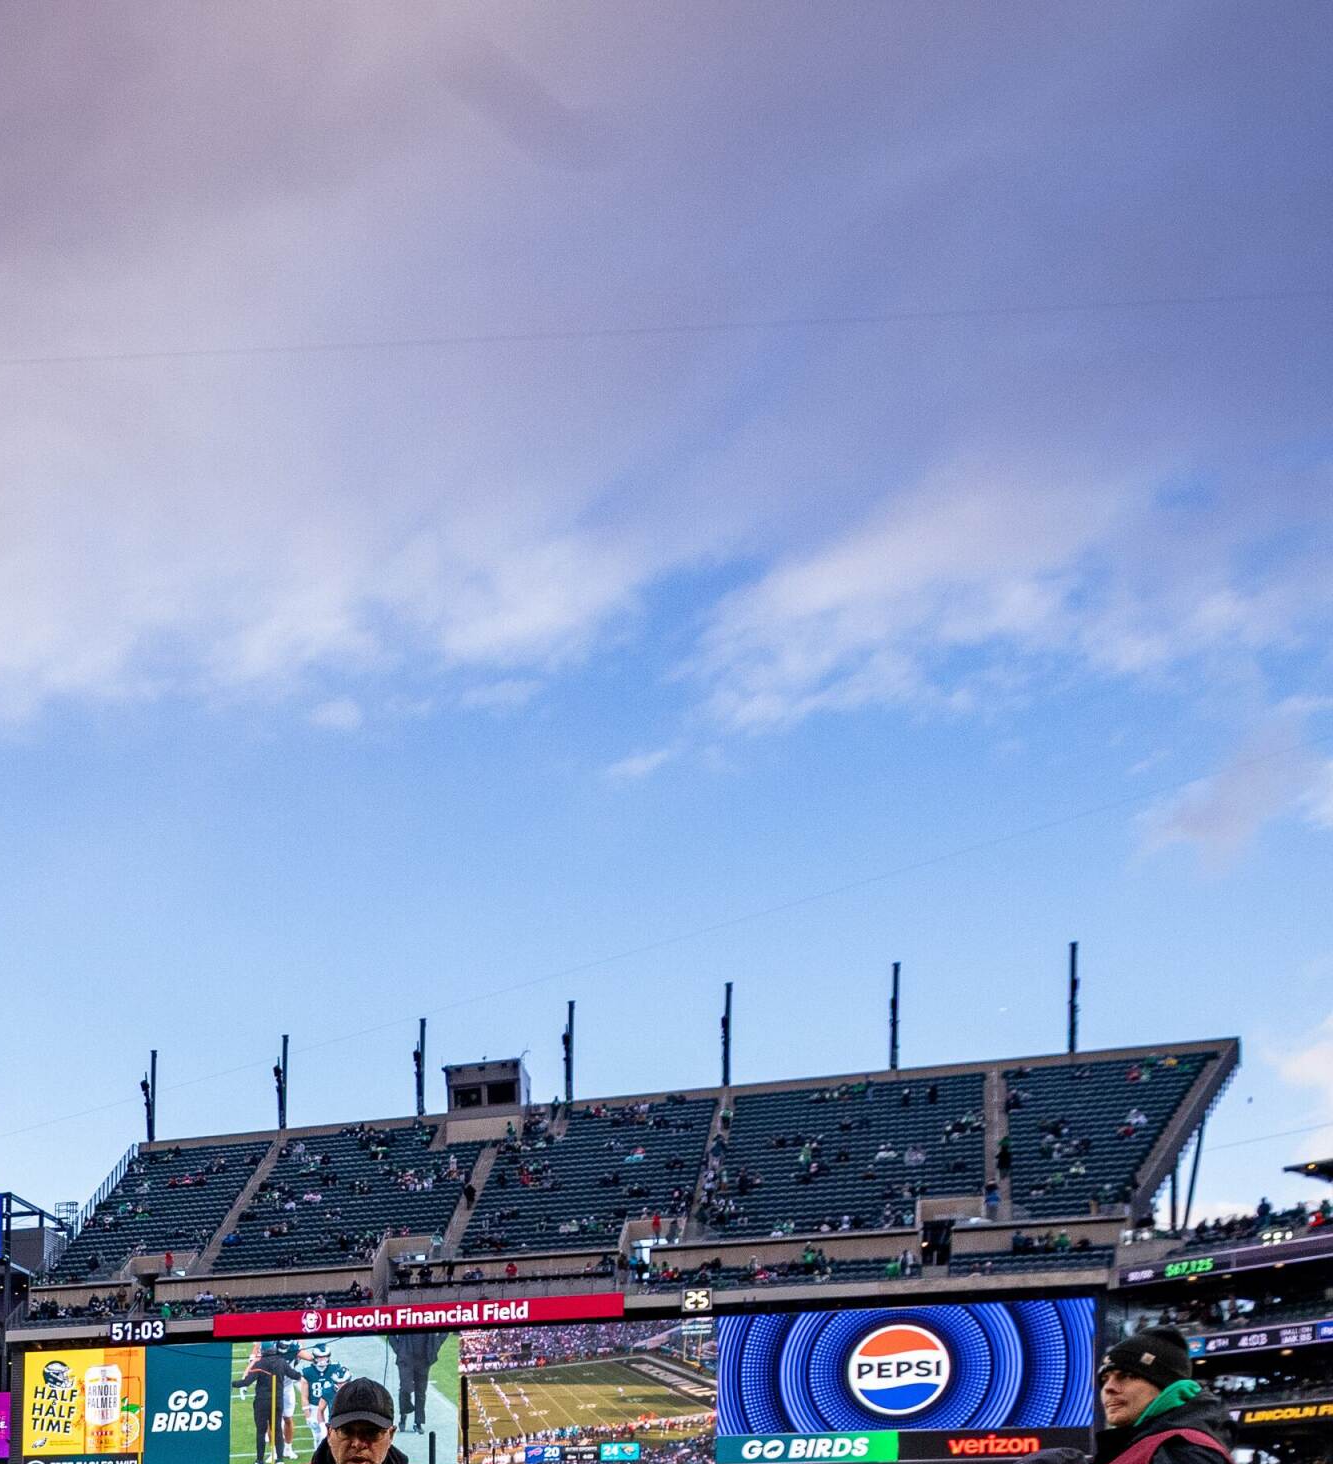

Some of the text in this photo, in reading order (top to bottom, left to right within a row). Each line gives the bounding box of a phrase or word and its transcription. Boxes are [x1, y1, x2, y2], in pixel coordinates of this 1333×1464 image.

[326, 1300, 529, 1330] Lincoln Financial Field
[111, 1321, 165, 1341] 51:03
[857, 1358, 942, 1379] PEPSI
[34, 1386, 78, 1402] HALF
[88, 1384, 118, 1397] ARNOLD
[87, 1397, 118, 1410] PALMER
[168, 1389, 209, 1412] GO
[32, 1403, 76, 1418] HALF
[1244, 1406, 1318, 1424] LINCOLN
[31, 1417, 72, 1434] TIME
[151, 1410, 224, 1433] BIRDS
[544, 1446, 560, 1458] 20
[602, 1445, 619, 1456] 24
[741, 1437, 870, 1460] GO BIRDS
[948, 1432, 1040, 1456] verizon
